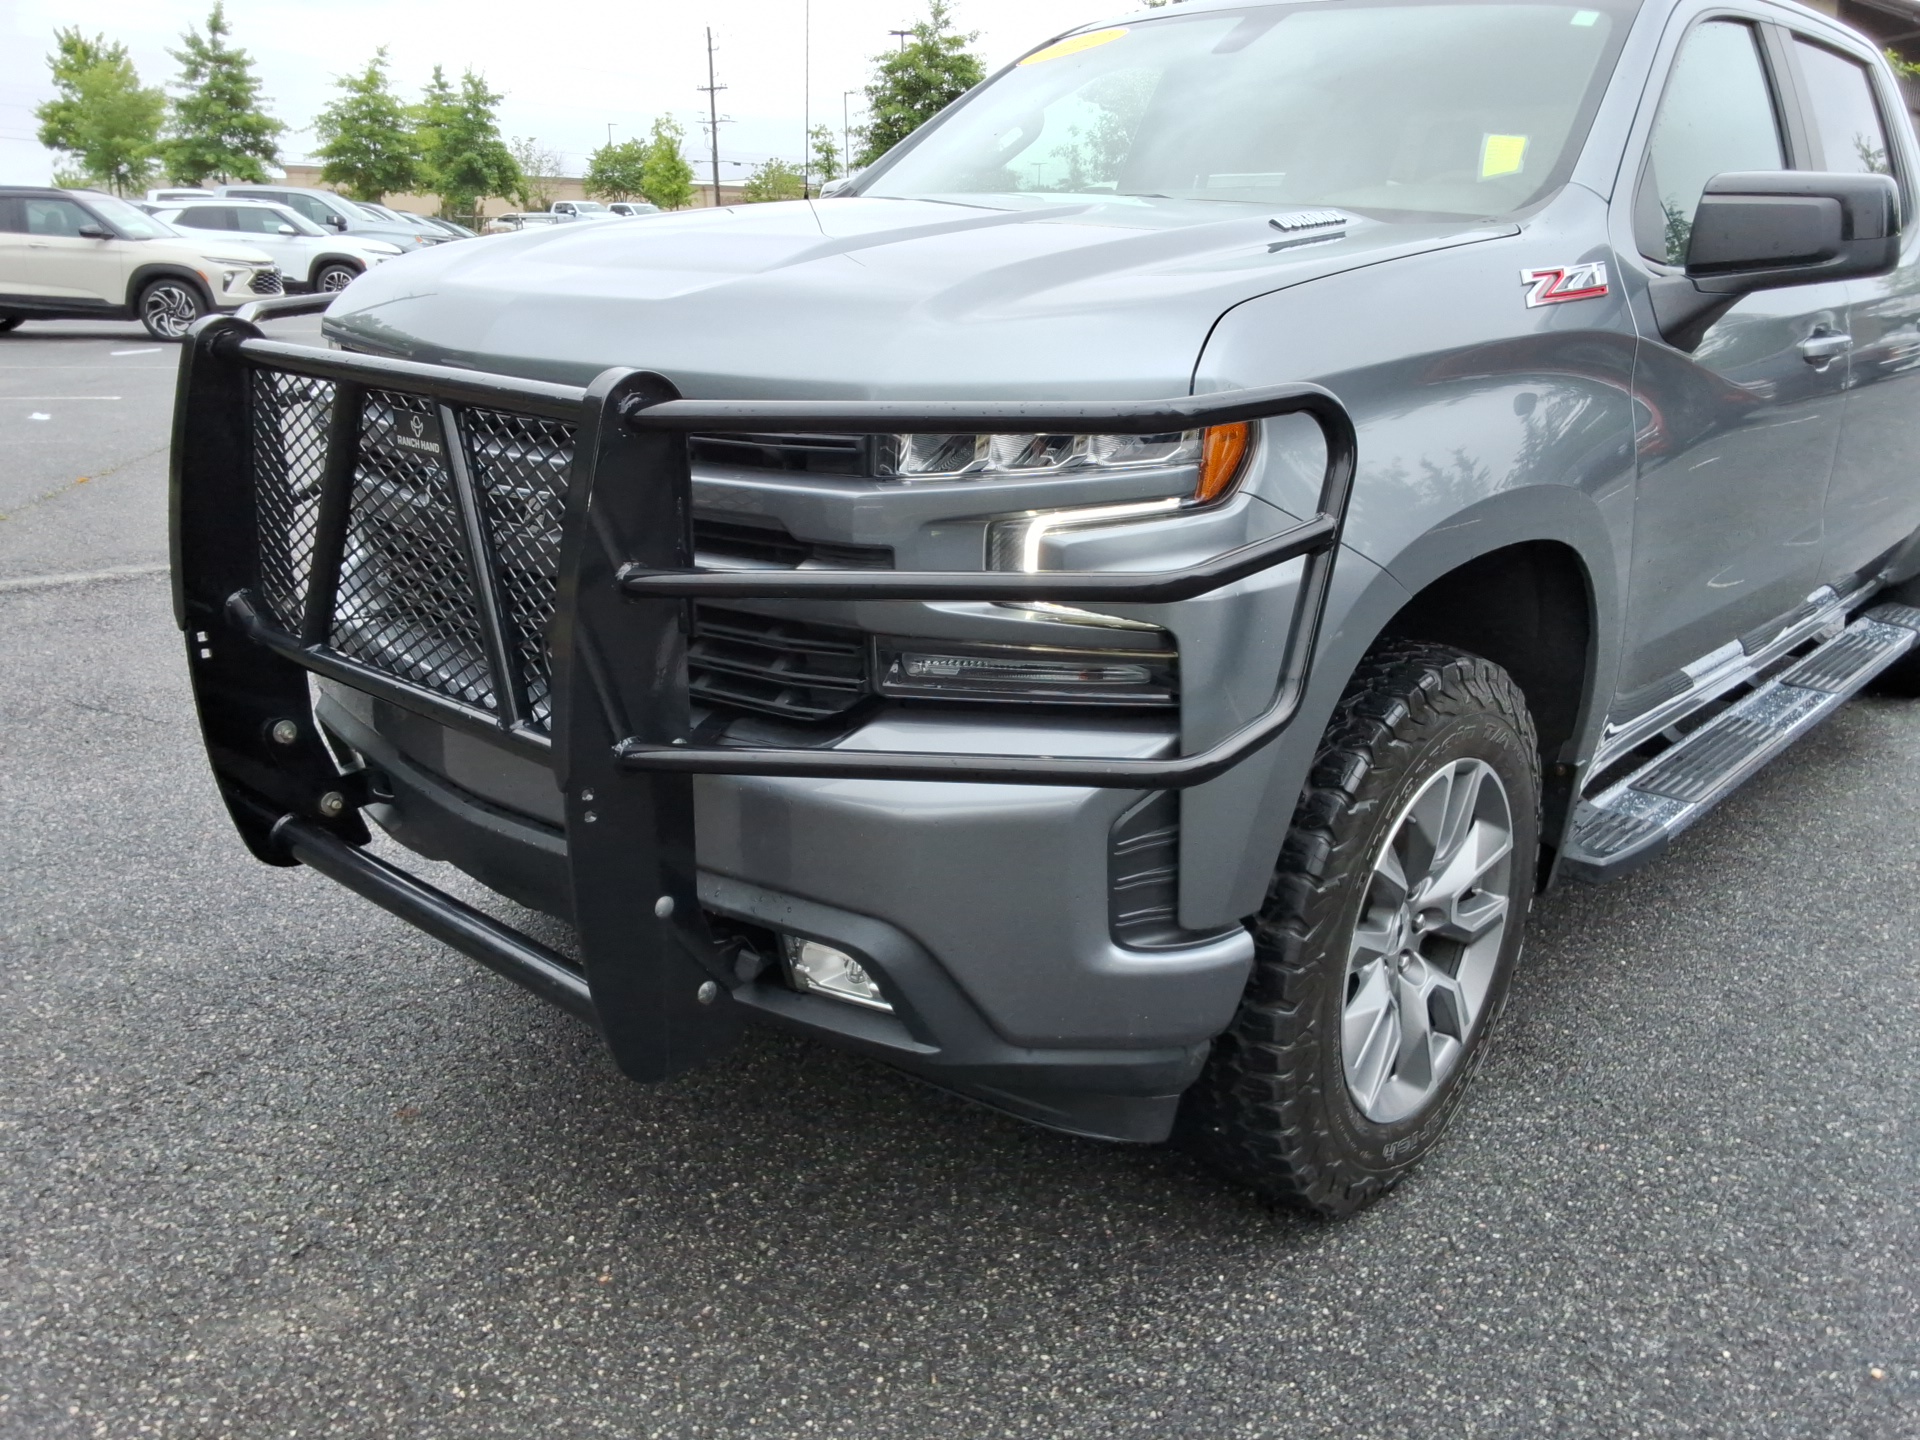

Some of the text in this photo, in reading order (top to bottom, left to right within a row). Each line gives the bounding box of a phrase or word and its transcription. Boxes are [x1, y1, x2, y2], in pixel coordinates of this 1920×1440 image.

[1520, 261, 1608, 309] Z71
[397, 435, 440, 453] RANCH HAND
